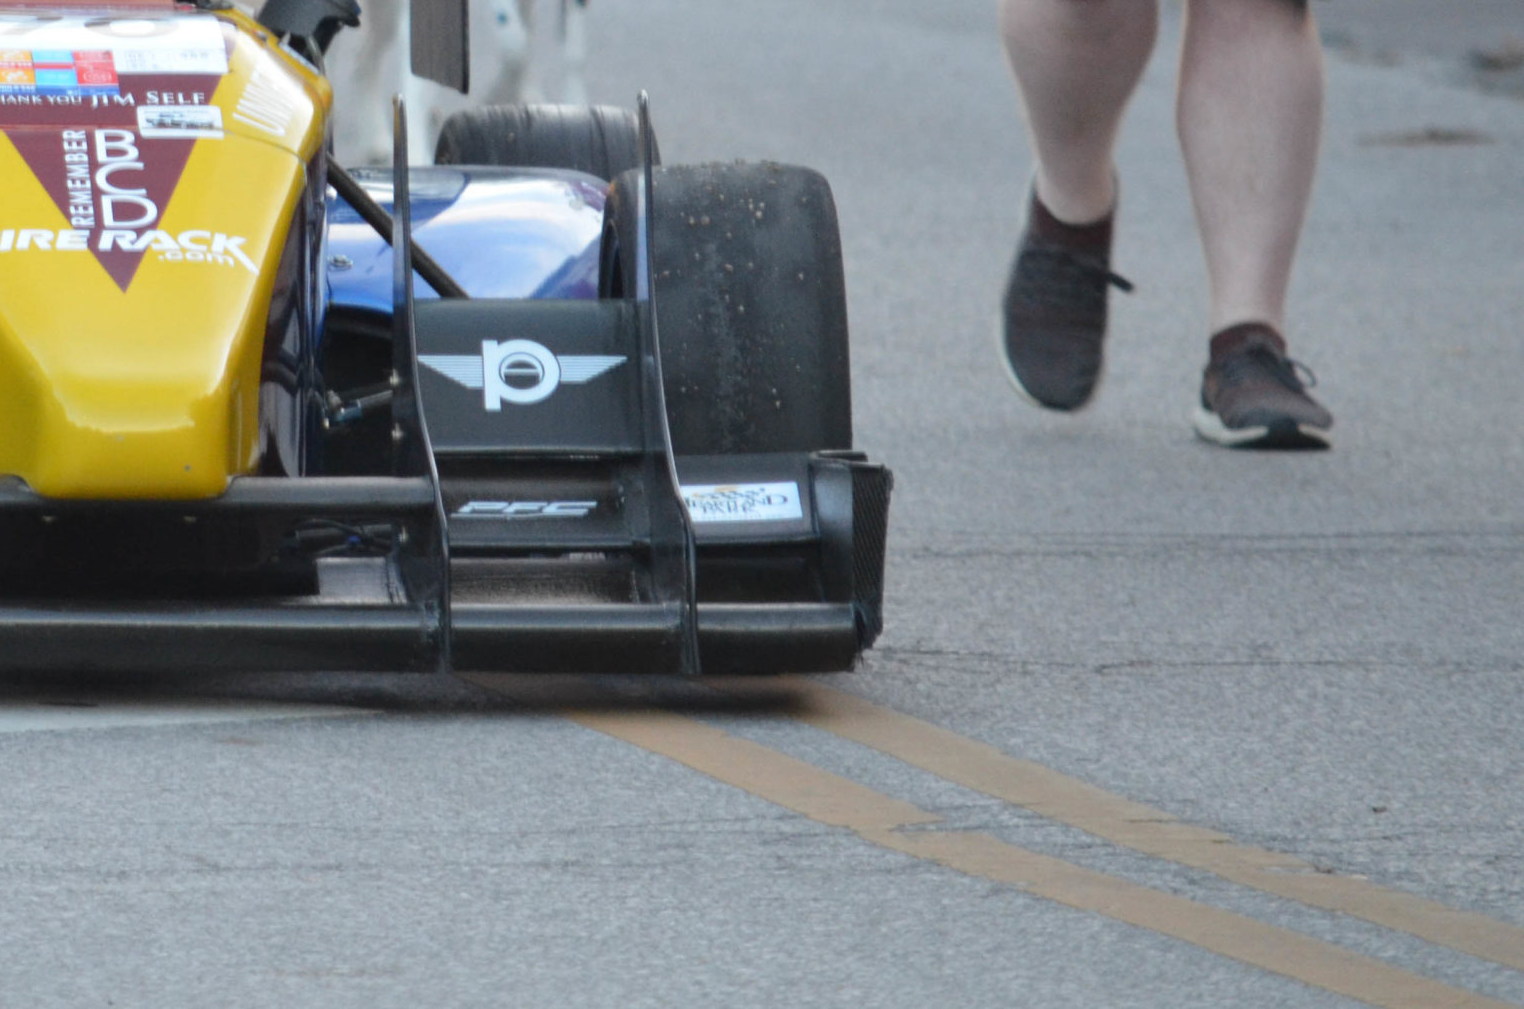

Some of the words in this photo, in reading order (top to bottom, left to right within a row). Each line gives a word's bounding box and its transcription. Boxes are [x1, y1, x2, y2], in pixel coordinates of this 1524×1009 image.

[46, 93, 82, 105] YOU
[89, 91, 136, 108] JIM
[146, 90, 206, 105] SELF
[62, 129, 95, 229] REMEMBER
[97, 229, 260, 276] RACK
[157, 250, 235, 268] .com
